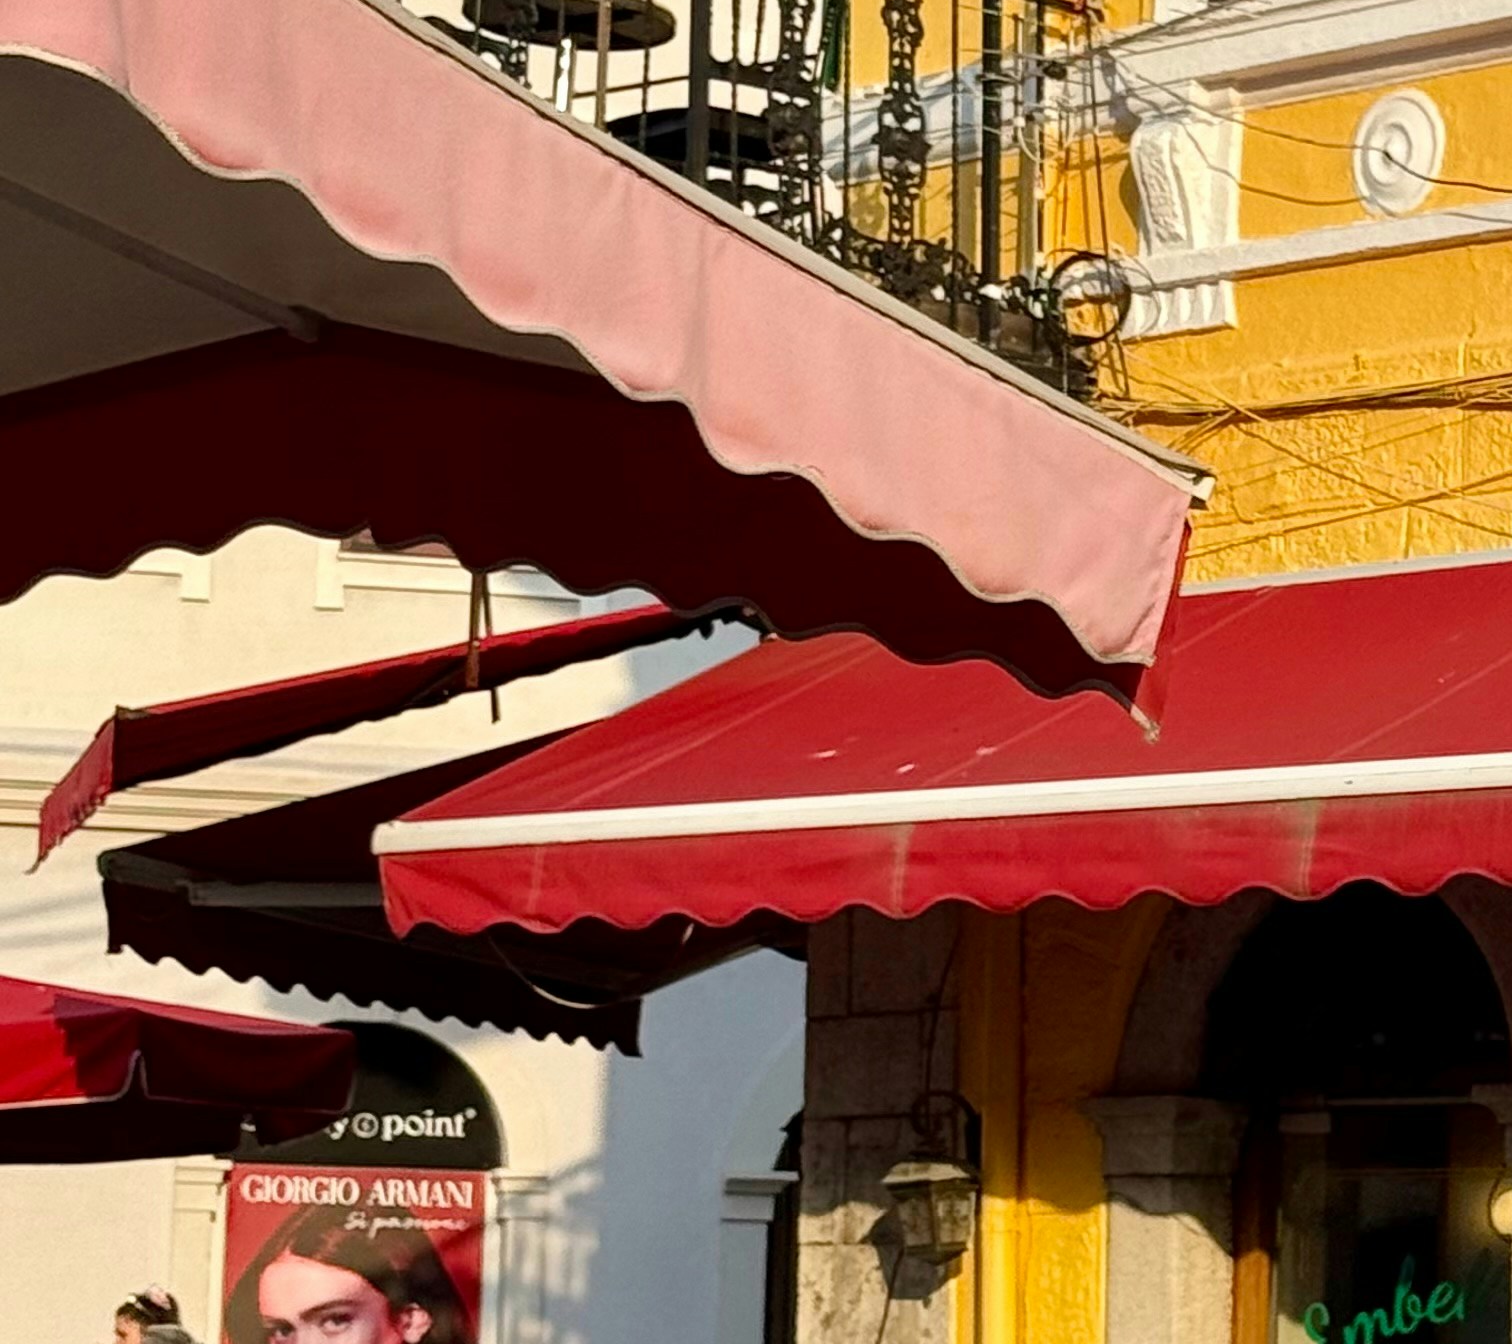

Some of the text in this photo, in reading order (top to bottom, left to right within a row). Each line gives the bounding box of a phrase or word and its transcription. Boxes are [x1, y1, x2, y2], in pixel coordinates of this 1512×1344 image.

[381, 1108, 469, 1142] point
[239, 1173, 474, 1210] GIORGIO ARMANI
